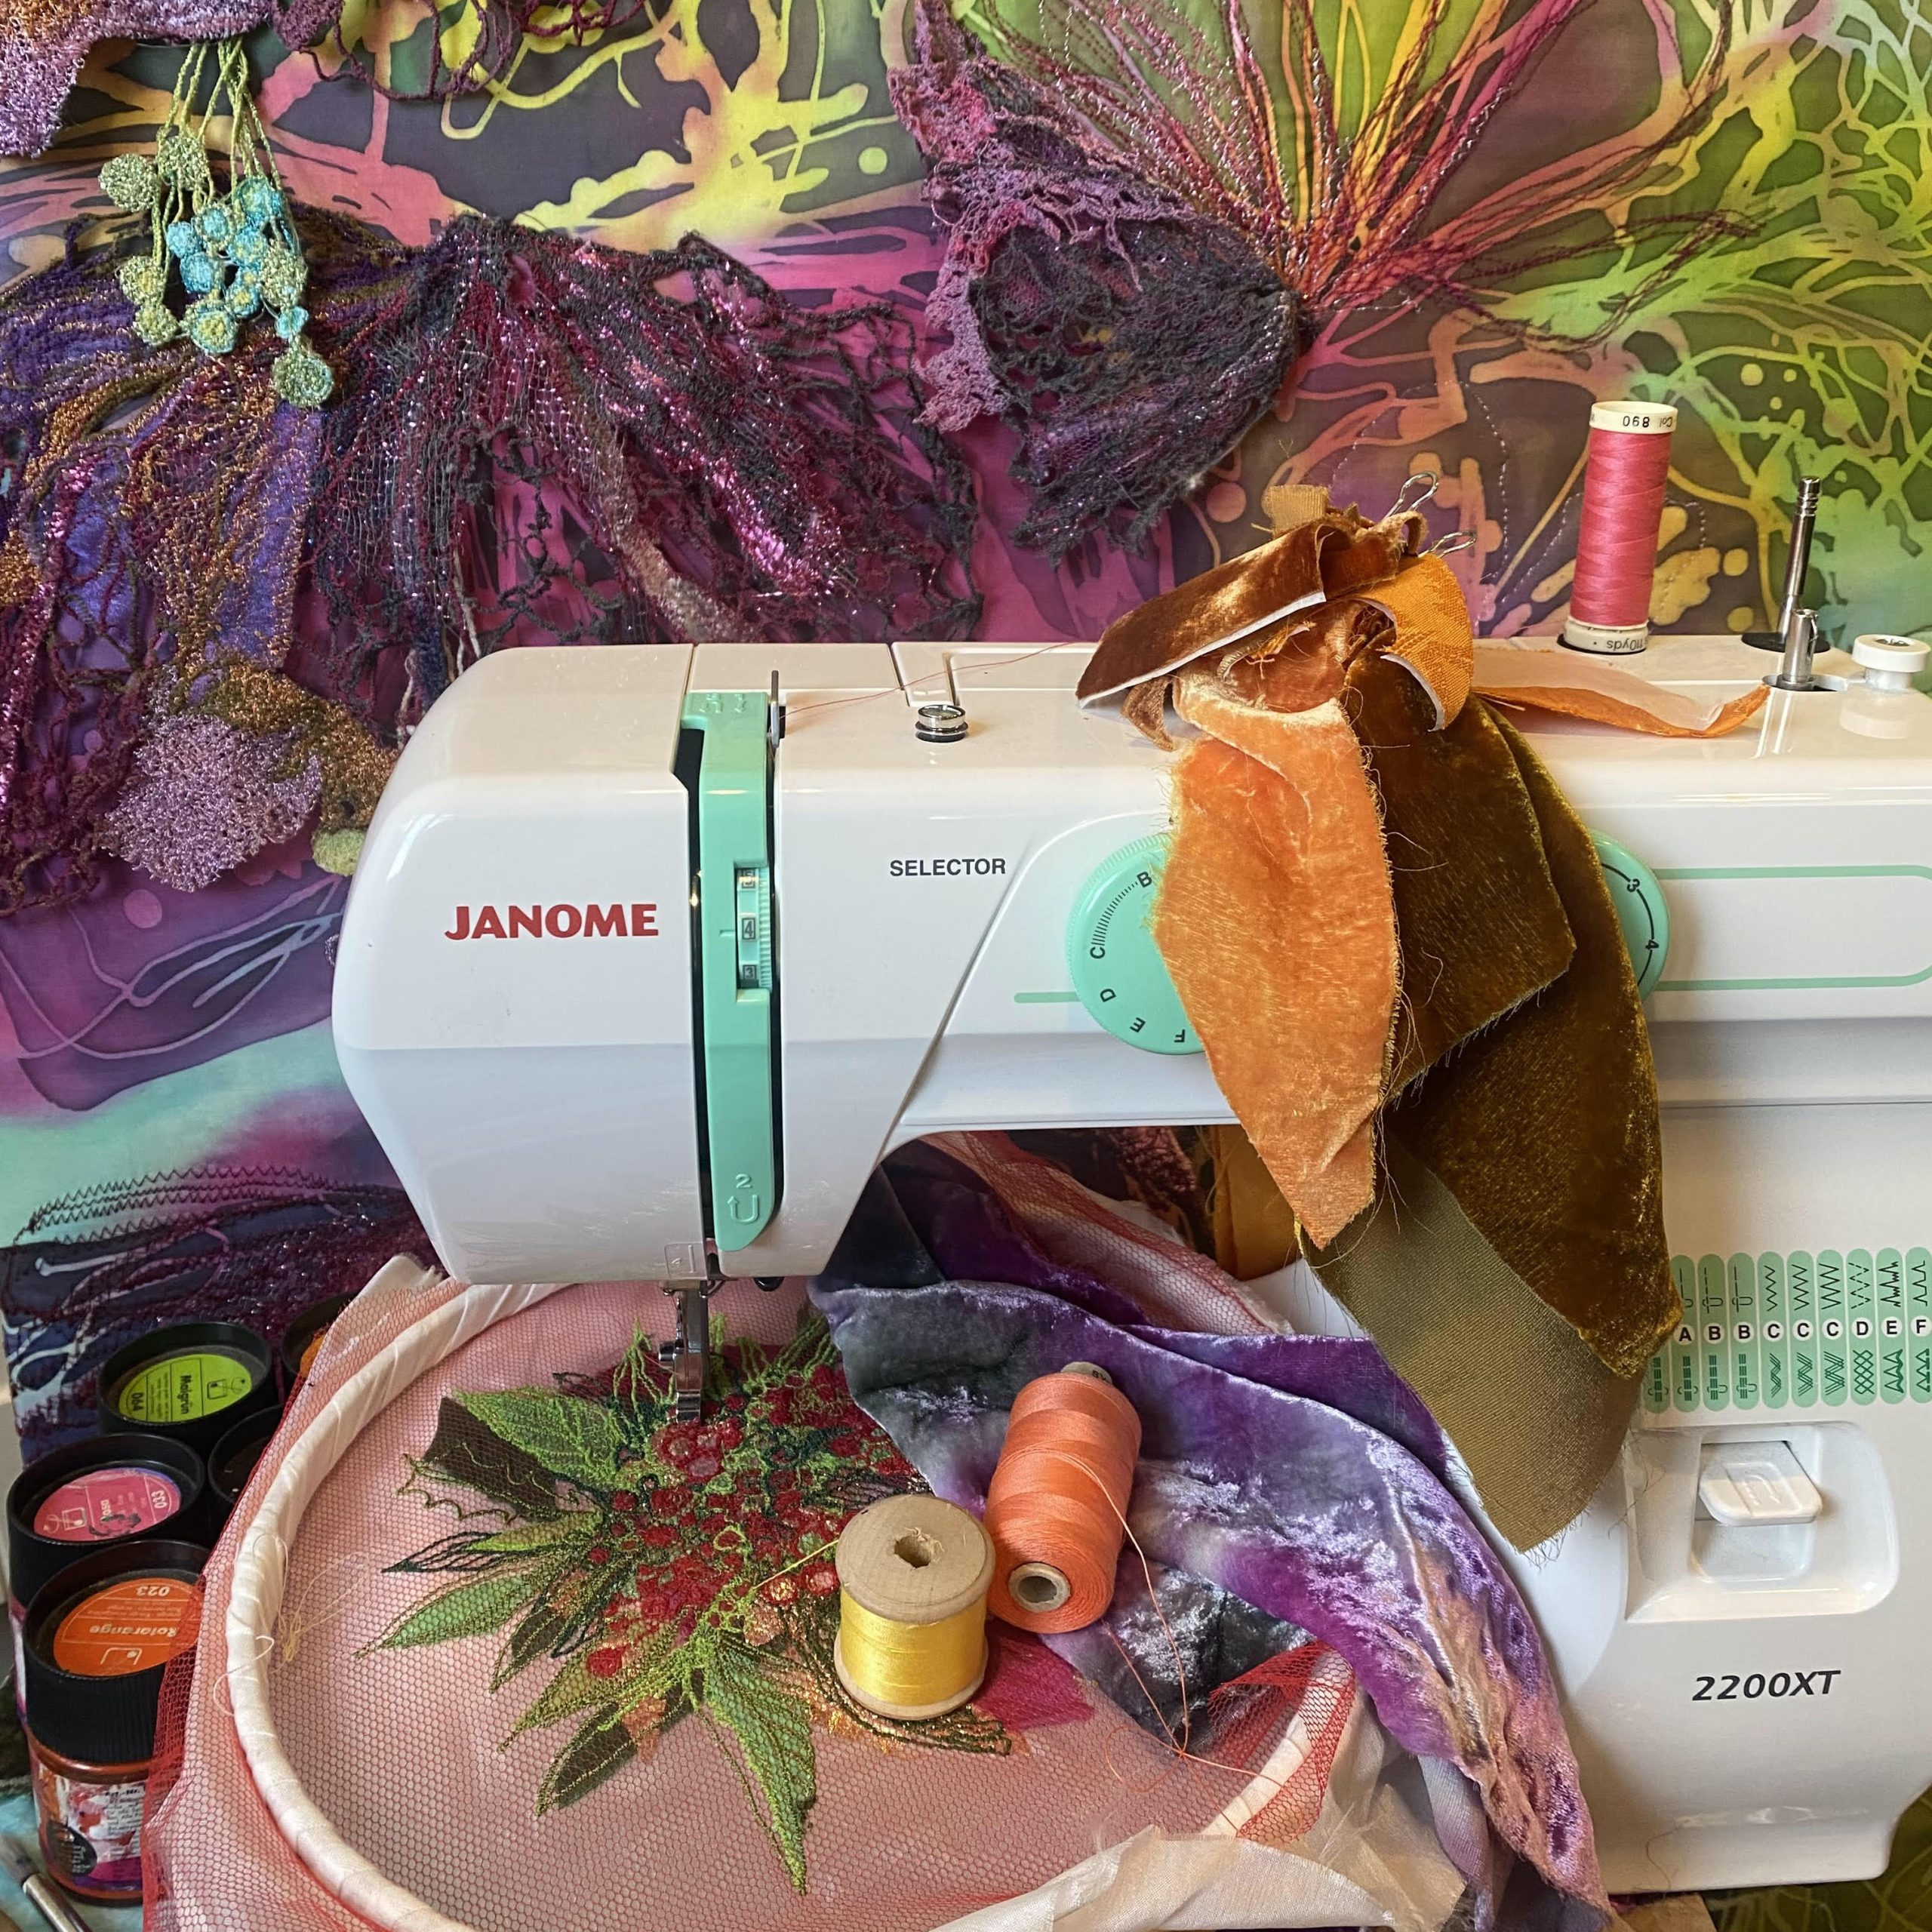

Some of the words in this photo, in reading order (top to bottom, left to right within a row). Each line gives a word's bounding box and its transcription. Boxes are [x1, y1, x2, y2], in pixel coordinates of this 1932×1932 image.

[1623, 415, 1650, 428] 890
[890, 858, 1006, 878] SELECTOR
[1137, 871, 1153, 888] B
[1626, 878, 1641, 892] 3
[444, 903, 659, 940] JANOME
[1645, 939, 1659, 950] 4
[1090, 946, 1106, 960] C
[1100, 988, 1116, 1003] D
[1130, 1017, 1146, 1033] E
[1174, 1029, 1186, 1043] F
[735, 1174, 753, 1189] 2
[1678, 1326, 1693, 1343] A
[1708, 1324, 1721, 1341] B
[1738, 1323, 1751, 1340] B
[1767, 1321, 1780, 1339] C
[1796, 1321, 1810, 1338] C
[1826, 1320, 1840, 1337] C
[1856, 1319, 1870, 1336] D
[1886, 1319, 1899, 1335] E
[1915, 1318, 1927, 1334] F
[151, 1490, 167, 1509] 033
[136, 1586, 170, 1597] 023
[1692, 1670, 1841, 1700] 2200XT
